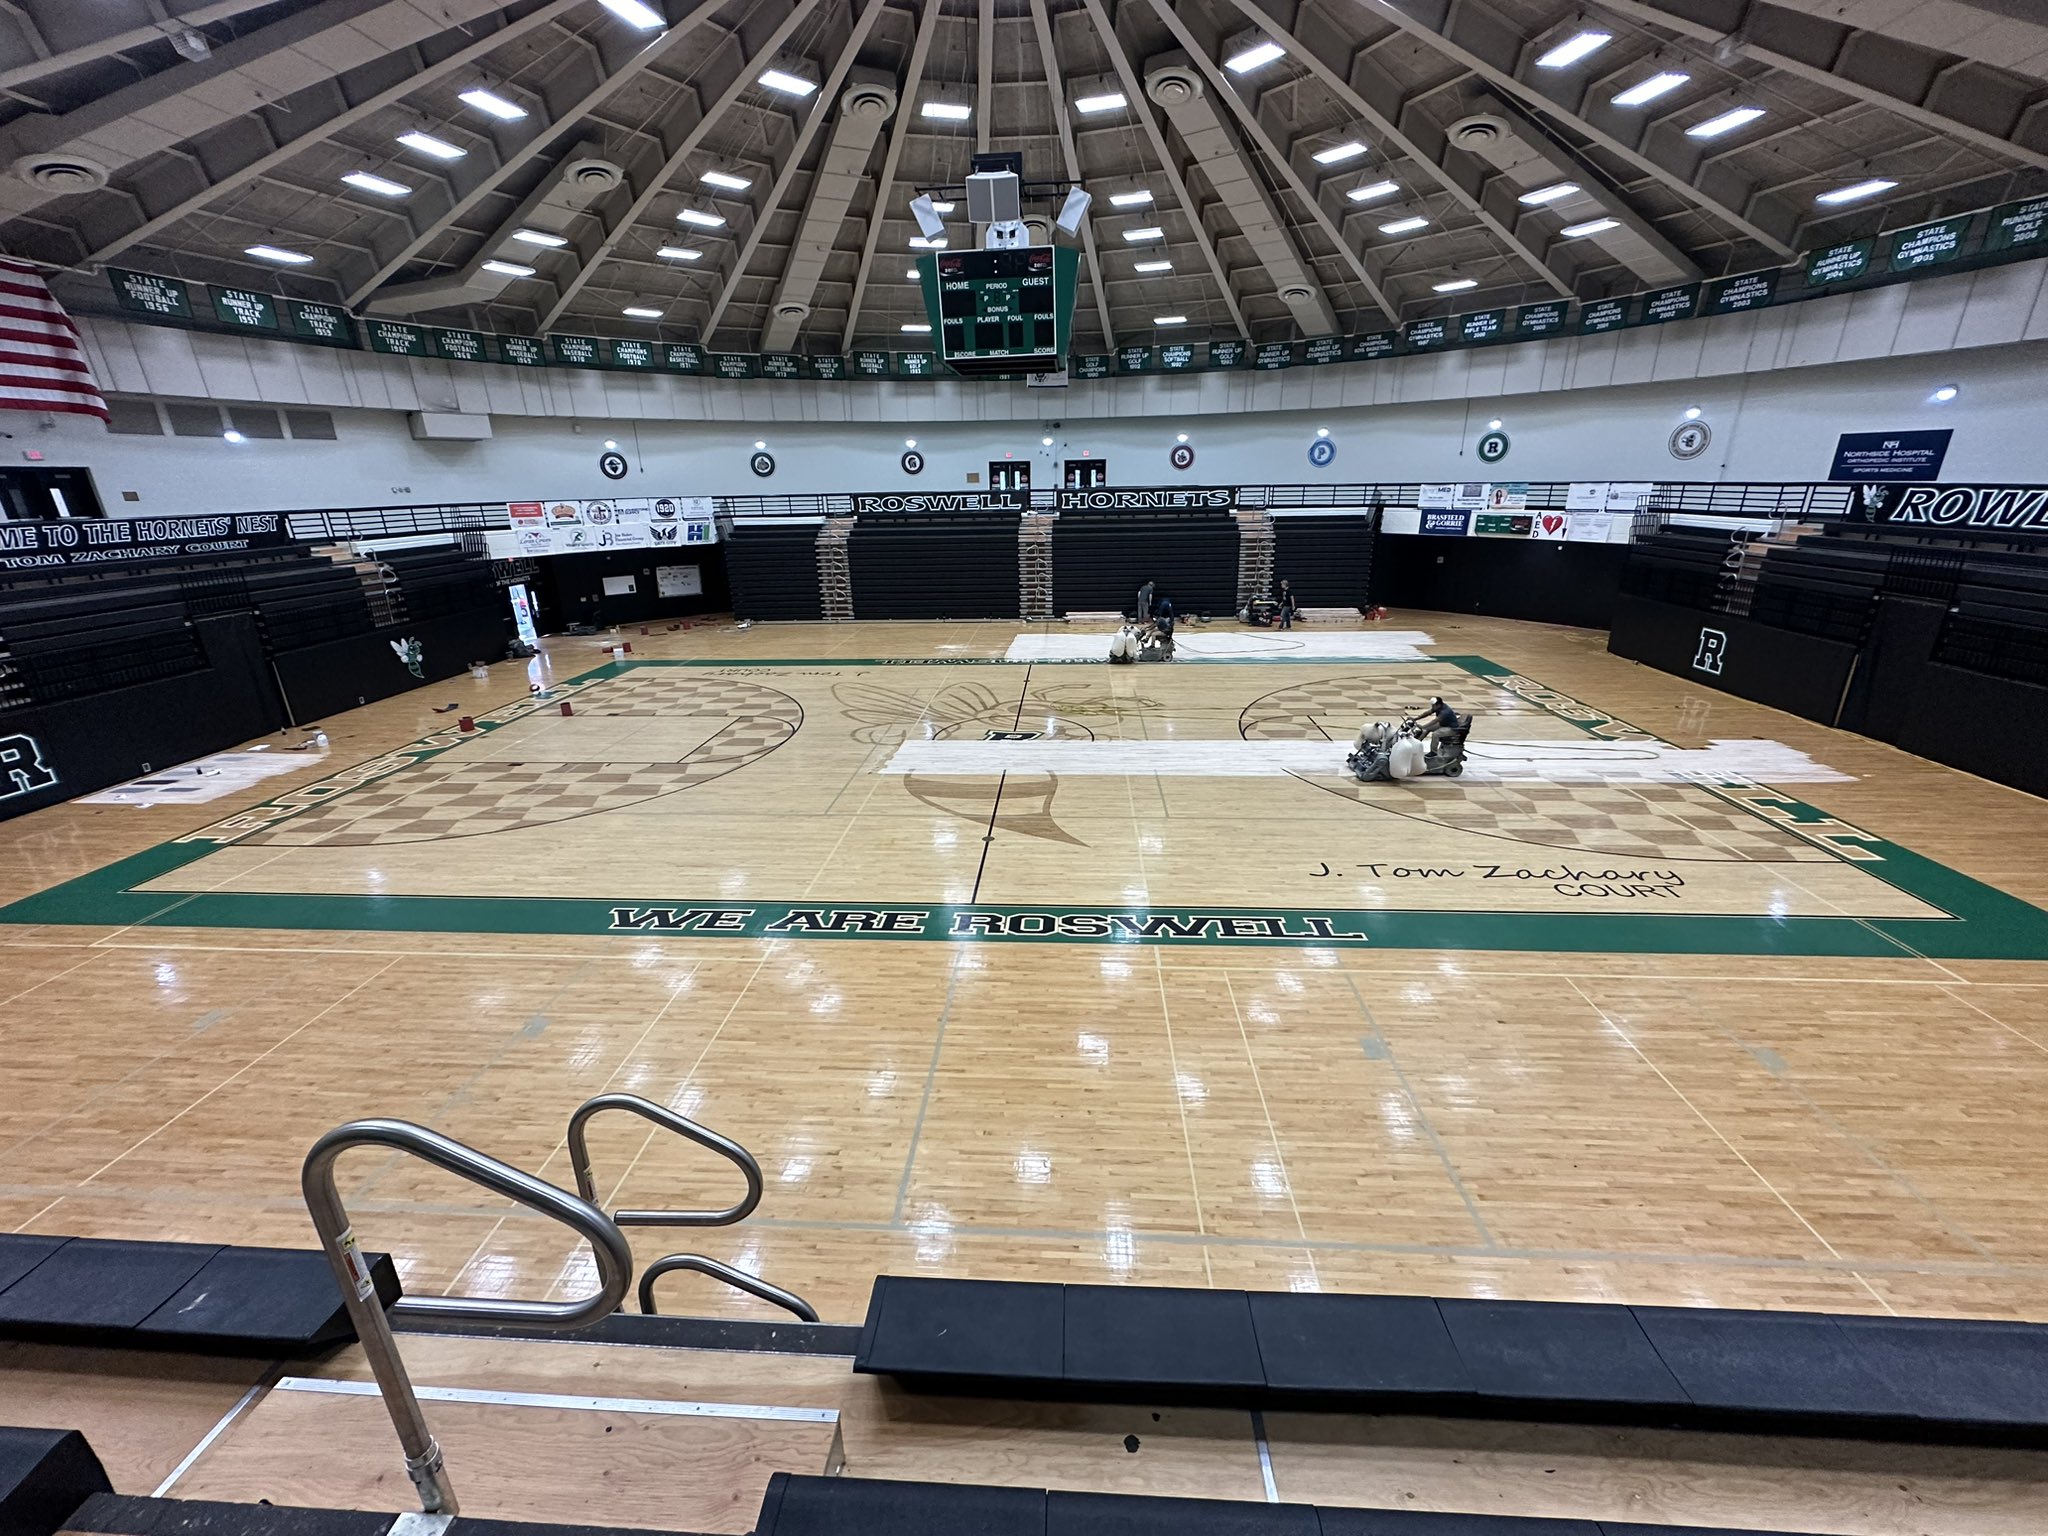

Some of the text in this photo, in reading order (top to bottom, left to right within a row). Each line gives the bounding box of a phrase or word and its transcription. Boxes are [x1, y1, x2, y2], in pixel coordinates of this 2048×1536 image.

[2014, 220, 2044, 232] GOLF
[1916, 226, 1947, 239] STATE
[2013, 230, 2038, 242] 2006
[1901, 232, 1956, 250] CHAMPIONS
[1828, 244, 1854, 257] STATE
[1897, 240, 1956, 259] GYMNASTICS
[1816, 251, 1862, 268] RUNNER UP
[1912, 253, 1934, 264] 2005
[1812, 258, 1862, 276] GYMNASTICS
[129, 275, 165, 288] STATE
[946, 282, 969, 290] HOME
[1022, 277, 1048, 286] GUEST
[1734, 276, 1759, 287] STATE
[124, 282, 178, 298] RUNNER UP
[1723, 282, 1768, 296] CHAMPIONS
[130, 290, 179, 306] FOOTBALL
[226, 290, 256, 302] STATE
[1661, 290, 1682, 300] STATE
[1720, 289, 1768, 304] GYMNASTICS
[144, 301, 170, 312] 1956
[222, 297, 264, 311] RUNNER UP
[1651, 295, 1690, 308] CHAMPIONS
[1732, 300, 1750, 308] 2003
[232, 307, 260, 318] TRACK
[304, 305, 329, 315] STATE
[1588, 308, 1621, 318] CHAMPIONS
[1649, 302, 1690, 314] GYMNASTICS
[239, 316, 258, 325] 1957
[300, 312, 337, 324] CHAMPIONS
[1522, 317, 1558, 326] GYMNASTICS
[1525, 312, 1558, 320] CHAMPIONS
[1586, 314, 1621, 325] GYMNASTICS
[310, 320, 334, 330] TRACK
[382, 324, 407, 334] STATE
[1466, 320, 1487, 328] RUNNER
[378, 330, 416, 342] CHAMPIONS
[446, 332, 470, 340] STATE
[1410, 326, 1442, 335] CHAMPIONS
[510, 338, 530, 346] STATE
[1408, 332, 1443, 341] GYMNASTICS
[386, 338, 410, 347] TRACK
[442, 338, 478, 348] CHAMPIONS
[560, 344, 592, 352] CHAMPIONS
[445, 344, 478, 354] FOOTBALL
[509, 350, 538, 358] BASEBALL
[616, 347, 647, 355] CHAMPIONS
[1306, 350, 1341, 358] GYMNASTICS
[1257, 356, 1290, 364] GYMNASTICS
[1486, 441, 1499, 454] R
[858, 494, 1021, 512] ROSWELL
[1061, 490, 1231, 509] HORNETS
[656, 503, 674, 514] 1920
[42, 524, 78, 547] TO
[82, 522, 131, 544] THE
[136, 516, 230, 541] HORNETS'
[236, 514, 278, 534] NEST
[0, 540, 248, 568] TOM ZACHARY COURT
[1693, 627, 1727, 675] R
[0, 734, 57, 799] R
[1309, 862, 1685, 886] J. Tom Zachary
[1554, 884, 1682, 898] COURT
[609, 906, 1368, 942] WE ARE ROSWELL
